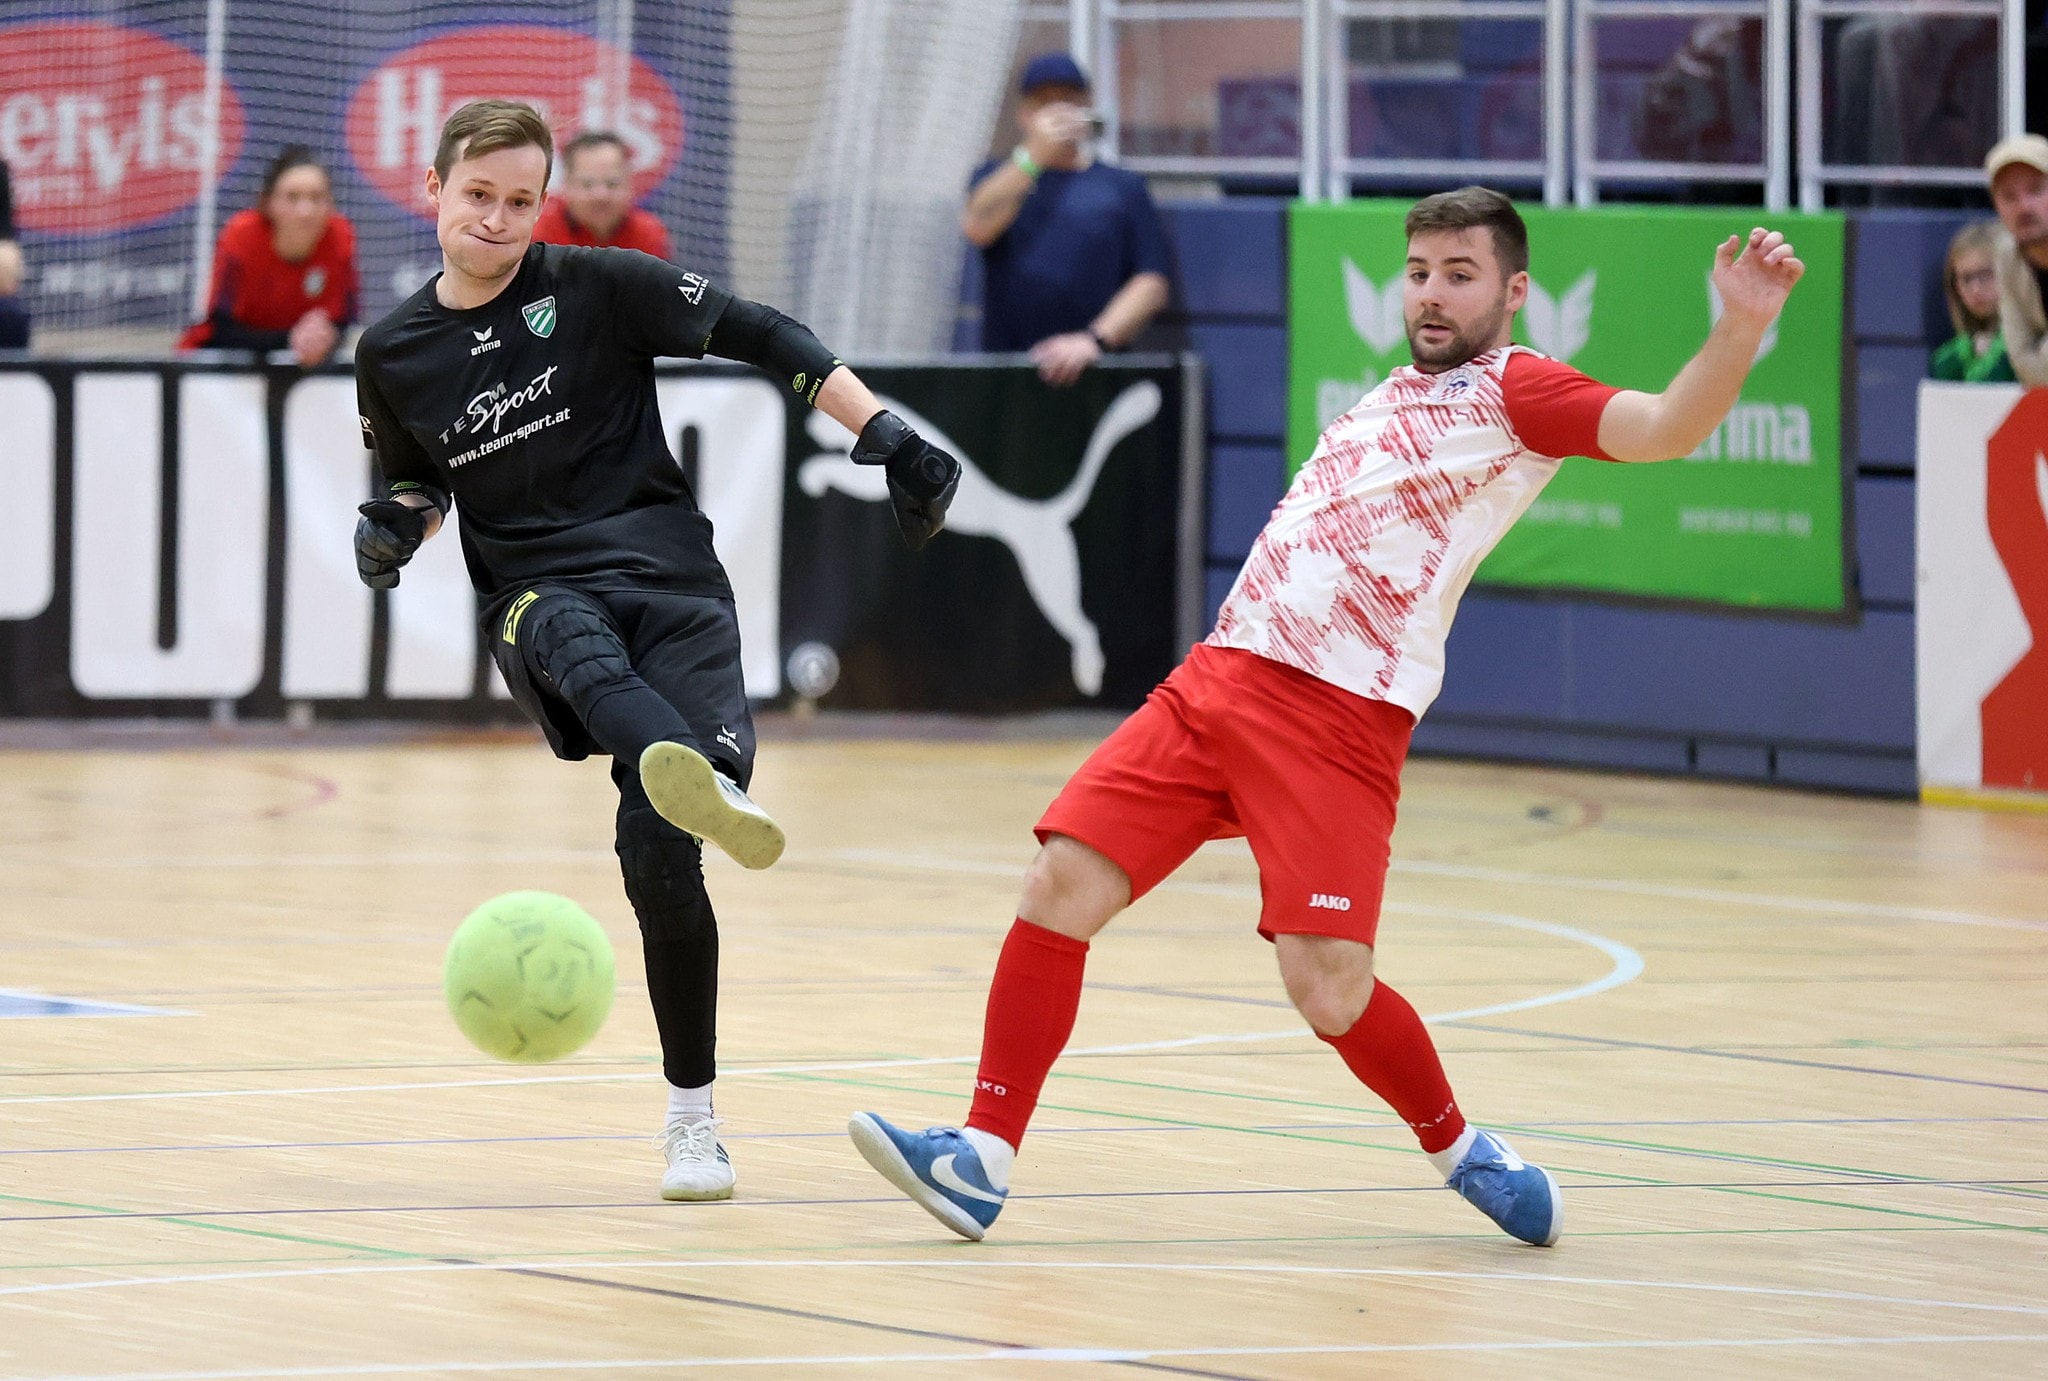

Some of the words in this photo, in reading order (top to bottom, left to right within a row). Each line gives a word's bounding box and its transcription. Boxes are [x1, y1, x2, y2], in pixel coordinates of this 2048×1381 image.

[376, 68, 664, 190] His
[470, 339, 501, 356] erima
[466, 365, 558, 434] Sport
[0, 370, 784, 700] UMA
[1308, 893, 1351, 911] JAKO
